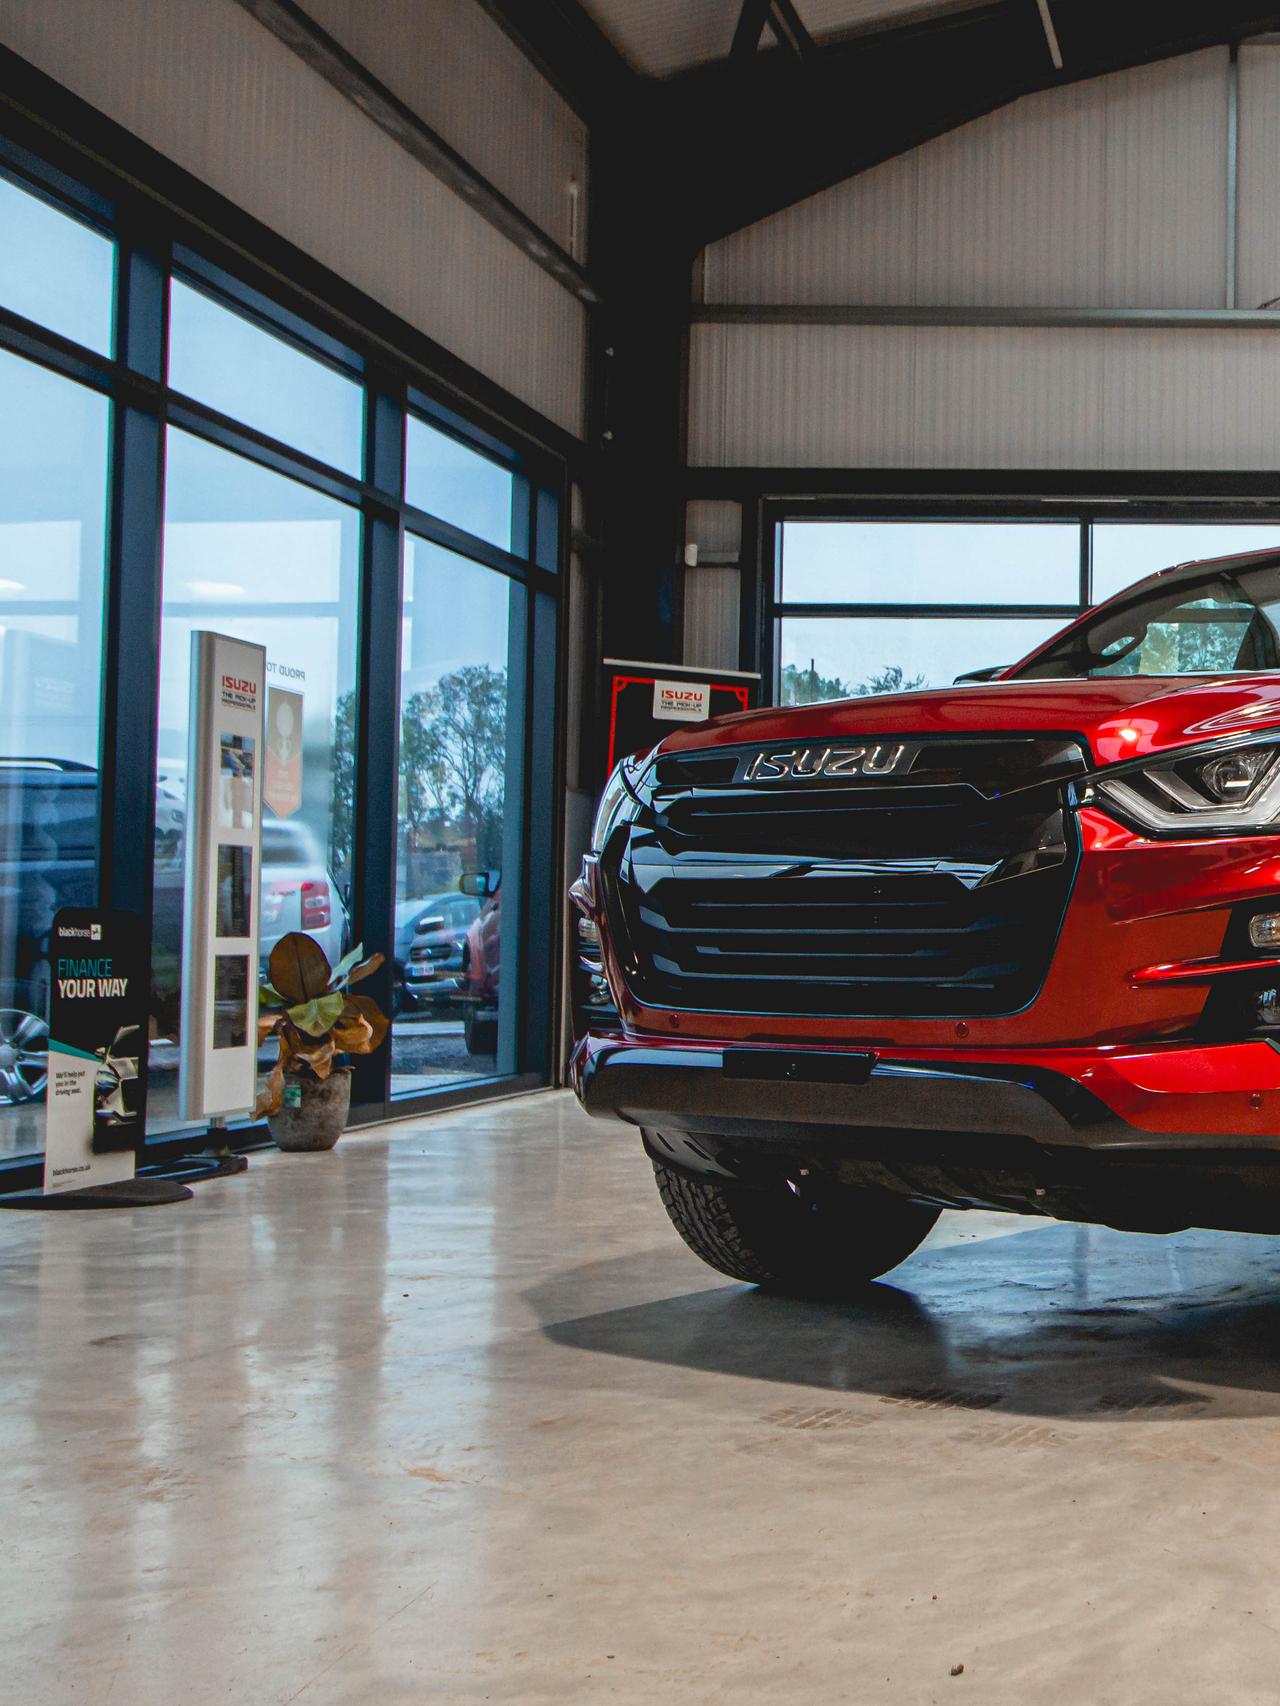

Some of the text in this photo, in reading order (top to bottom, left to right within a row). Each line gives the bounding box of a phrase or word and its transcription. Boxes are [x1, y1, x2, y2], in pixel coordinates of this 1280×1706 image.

[222, 675, 257, 694] ISUZU
[661, 690, 703, 701] ISUZU
[743, 744, 905, 781] ISUZU
[58, 927, 91, 938] blackhorse
[58, 958, 113, 978] FINANCE
[58, 978, 128, 999] YOUR WAY
